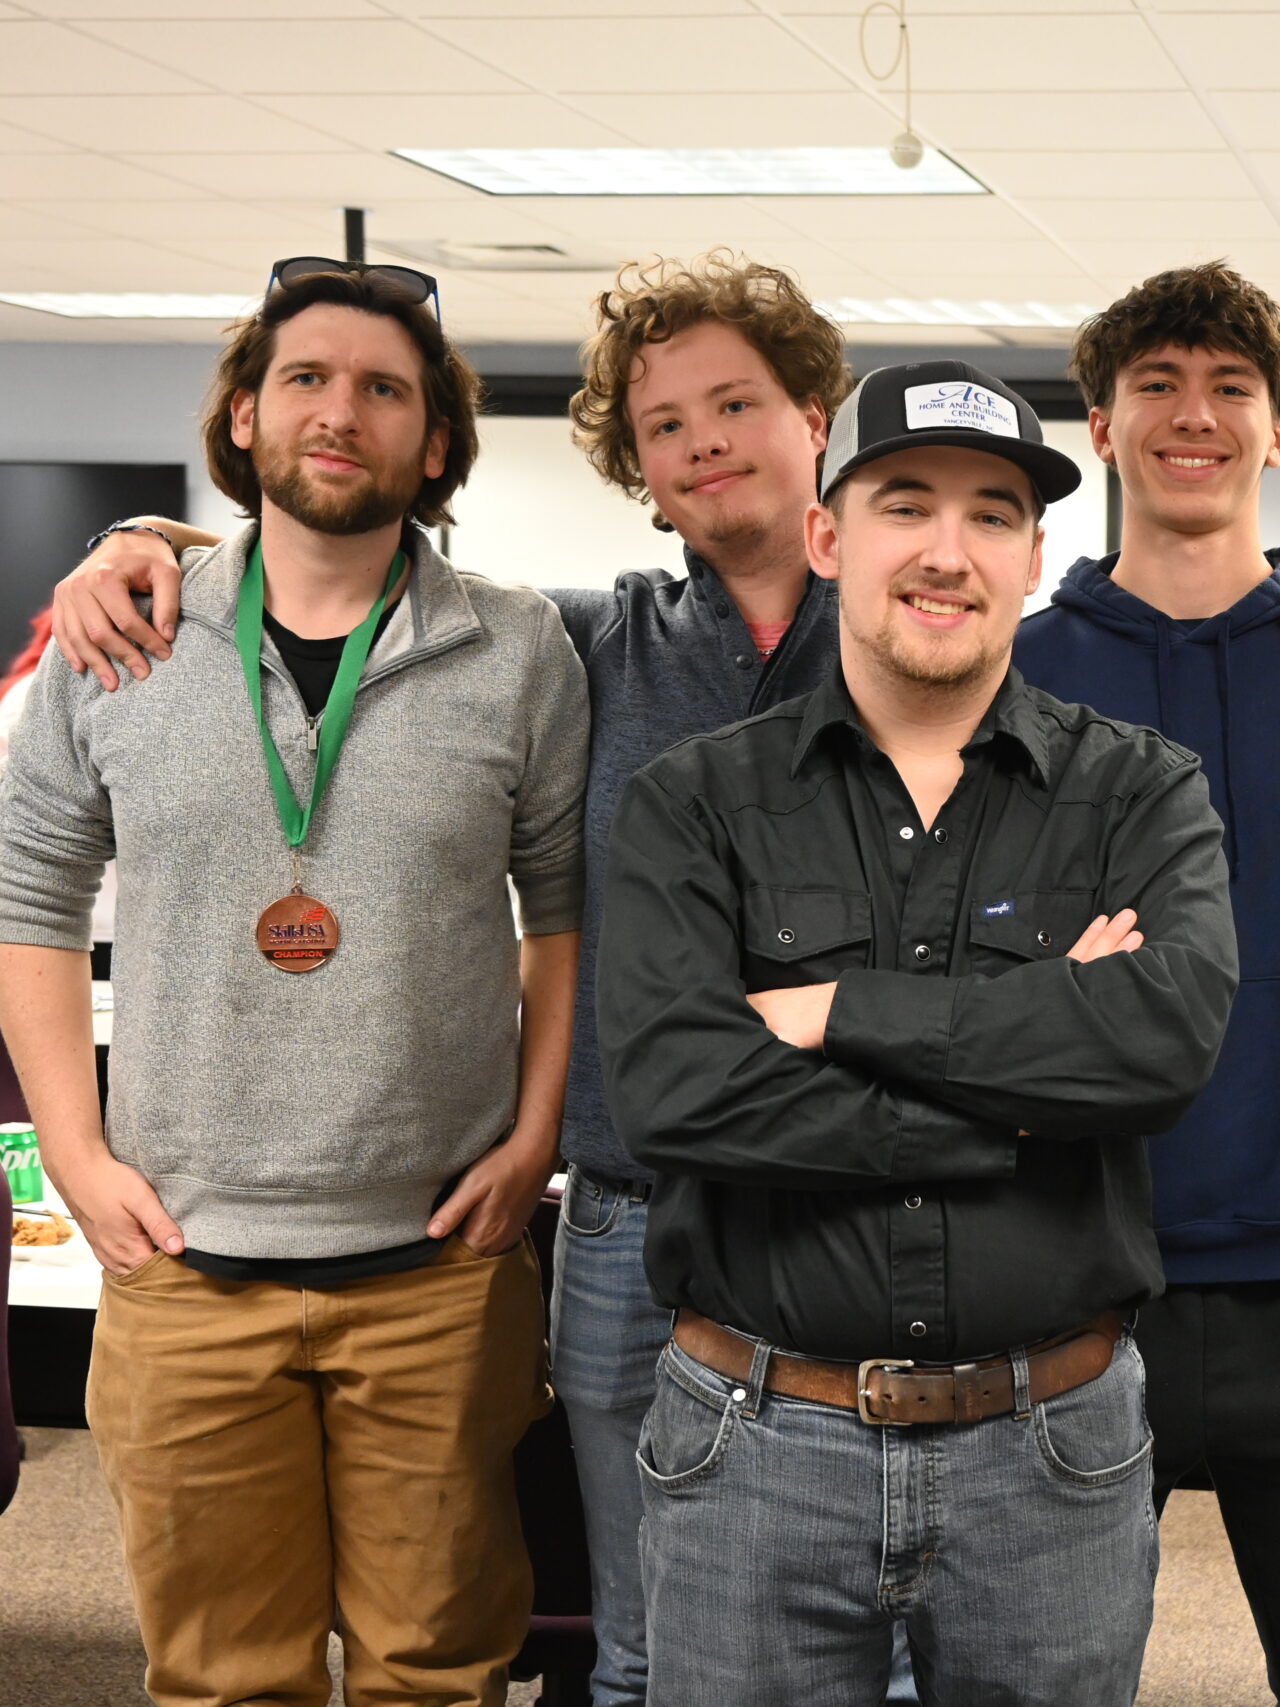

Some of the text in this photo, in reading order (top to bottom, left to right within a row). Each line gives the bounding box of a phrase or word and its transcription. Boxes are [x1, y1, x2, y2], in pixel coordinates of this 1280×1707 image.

[919, 402, 1012, 426] HOME AND BUILDING
[951, 409, 986, 422] CENTER
[267, 923, 327, 938] SkillsUSA
[273, 950, 324, 959] CHAMPION
